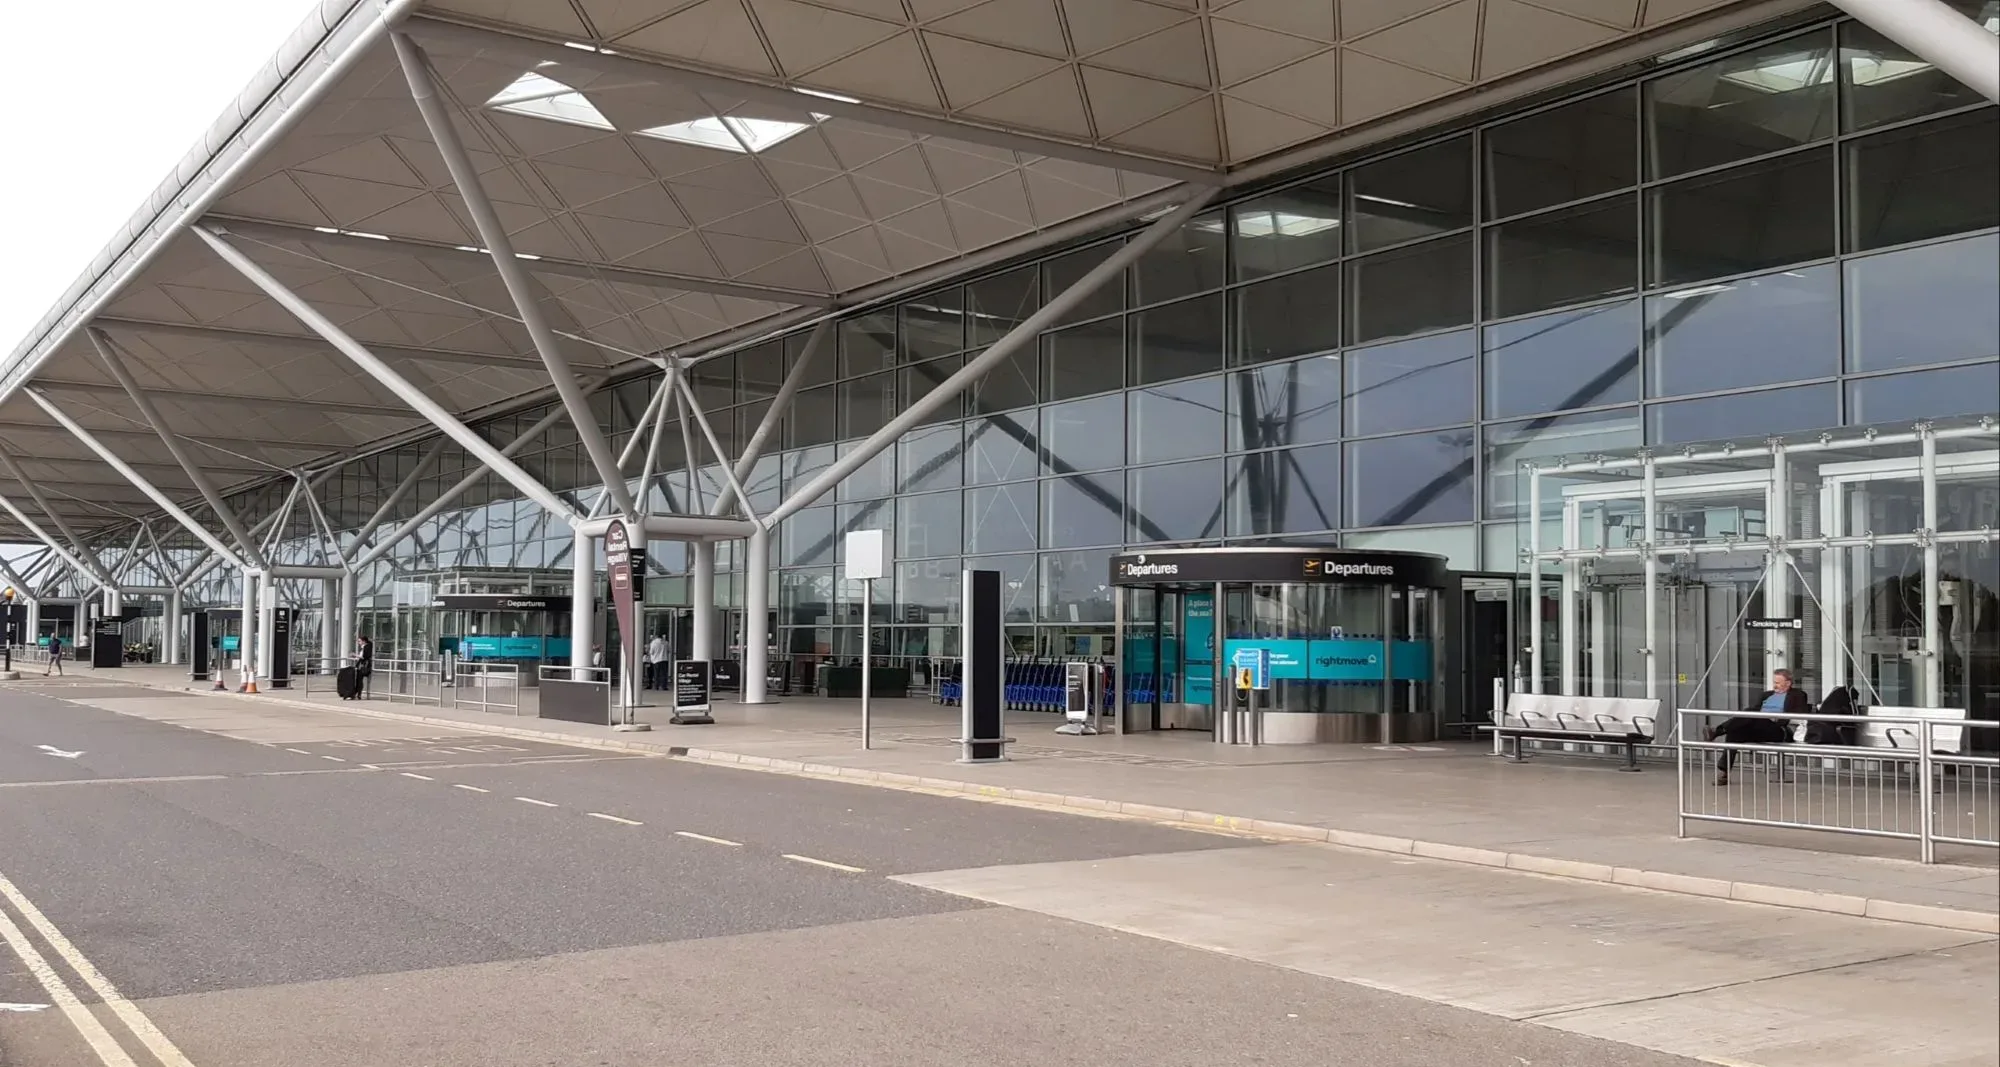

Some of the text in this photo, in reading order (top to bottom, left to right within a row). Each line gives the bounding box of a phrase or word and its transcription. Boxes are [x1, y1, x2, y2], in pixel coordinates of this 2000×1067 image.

[1127, 563, 1178, 578] Departures
[1324, 561, 1394, 576] Departures
[507, 599, 546, 607] Departures
[1752, 620, 1778, 628] Smoking
[1315, 656, 1369, 667] rightmove
